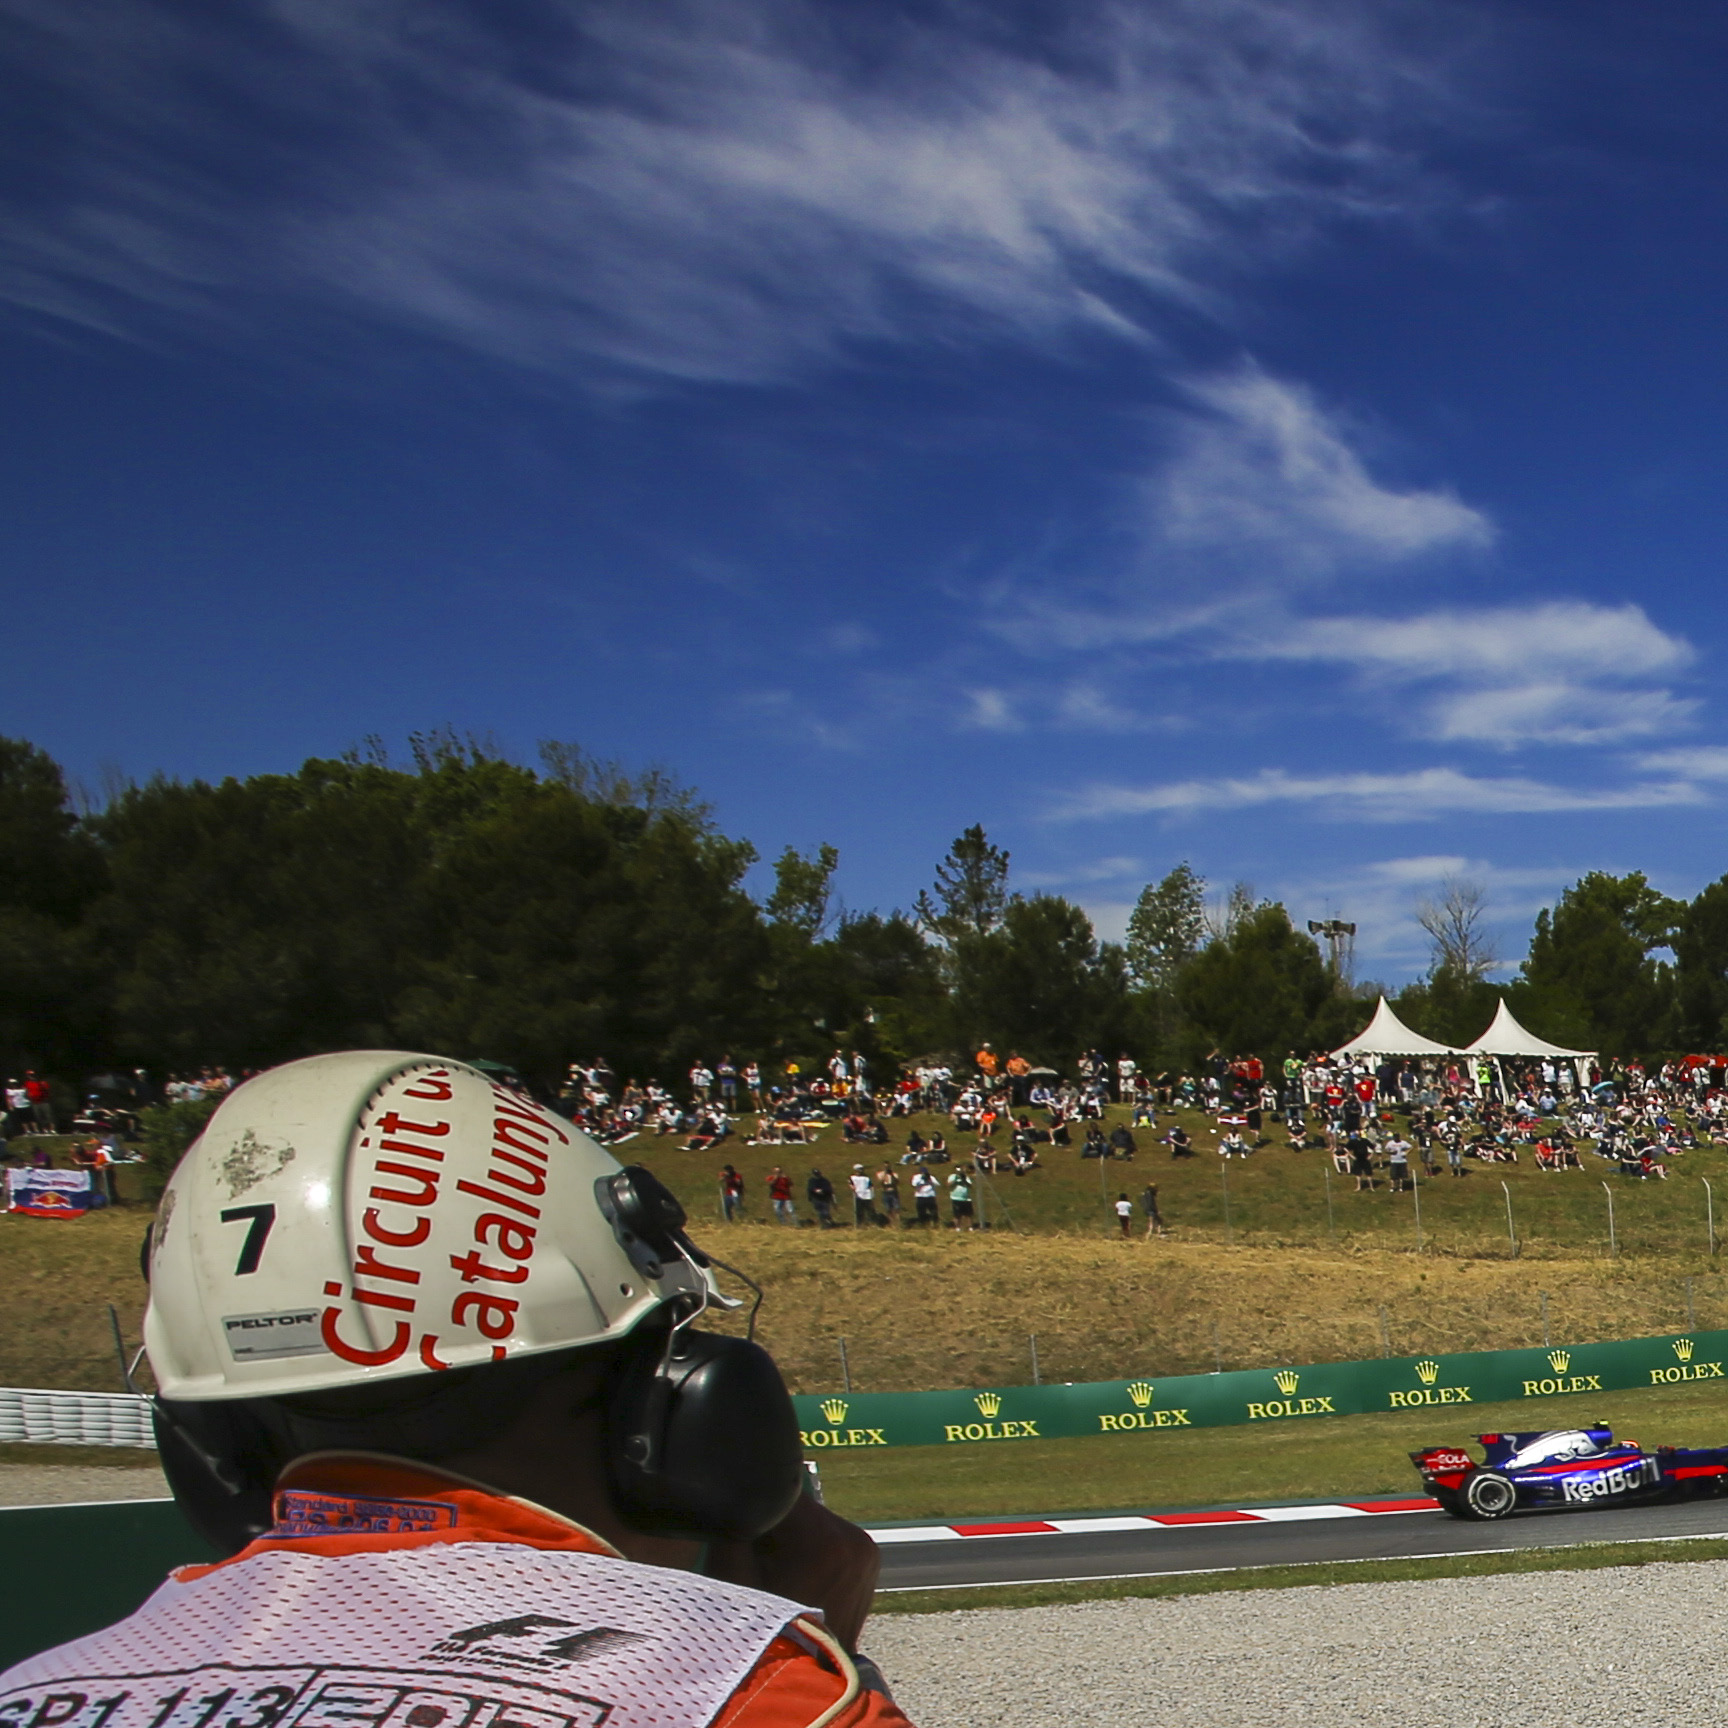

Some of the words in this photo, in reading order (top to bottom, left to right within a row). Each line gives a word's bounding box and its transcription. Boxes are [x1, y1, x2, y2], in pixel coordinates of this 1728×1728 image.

[221, 1203, 275, 1276] 7
[321, 1112, 452, 1366] Circuit
[226, 1314, 315, 1330] PELTOR
[1650, 1362, 1724, 1384] ROLEX
[1523, 1375, 1602, 1395] ROLEX
[1248, 1397, 1335, 1418] ROLEX
[1390, 1387, 1472, 1407] ROLEX
[1099, 1409, 1191, 1430] ROLEX
[945, 1421, 1040, 1441] ROLEX
